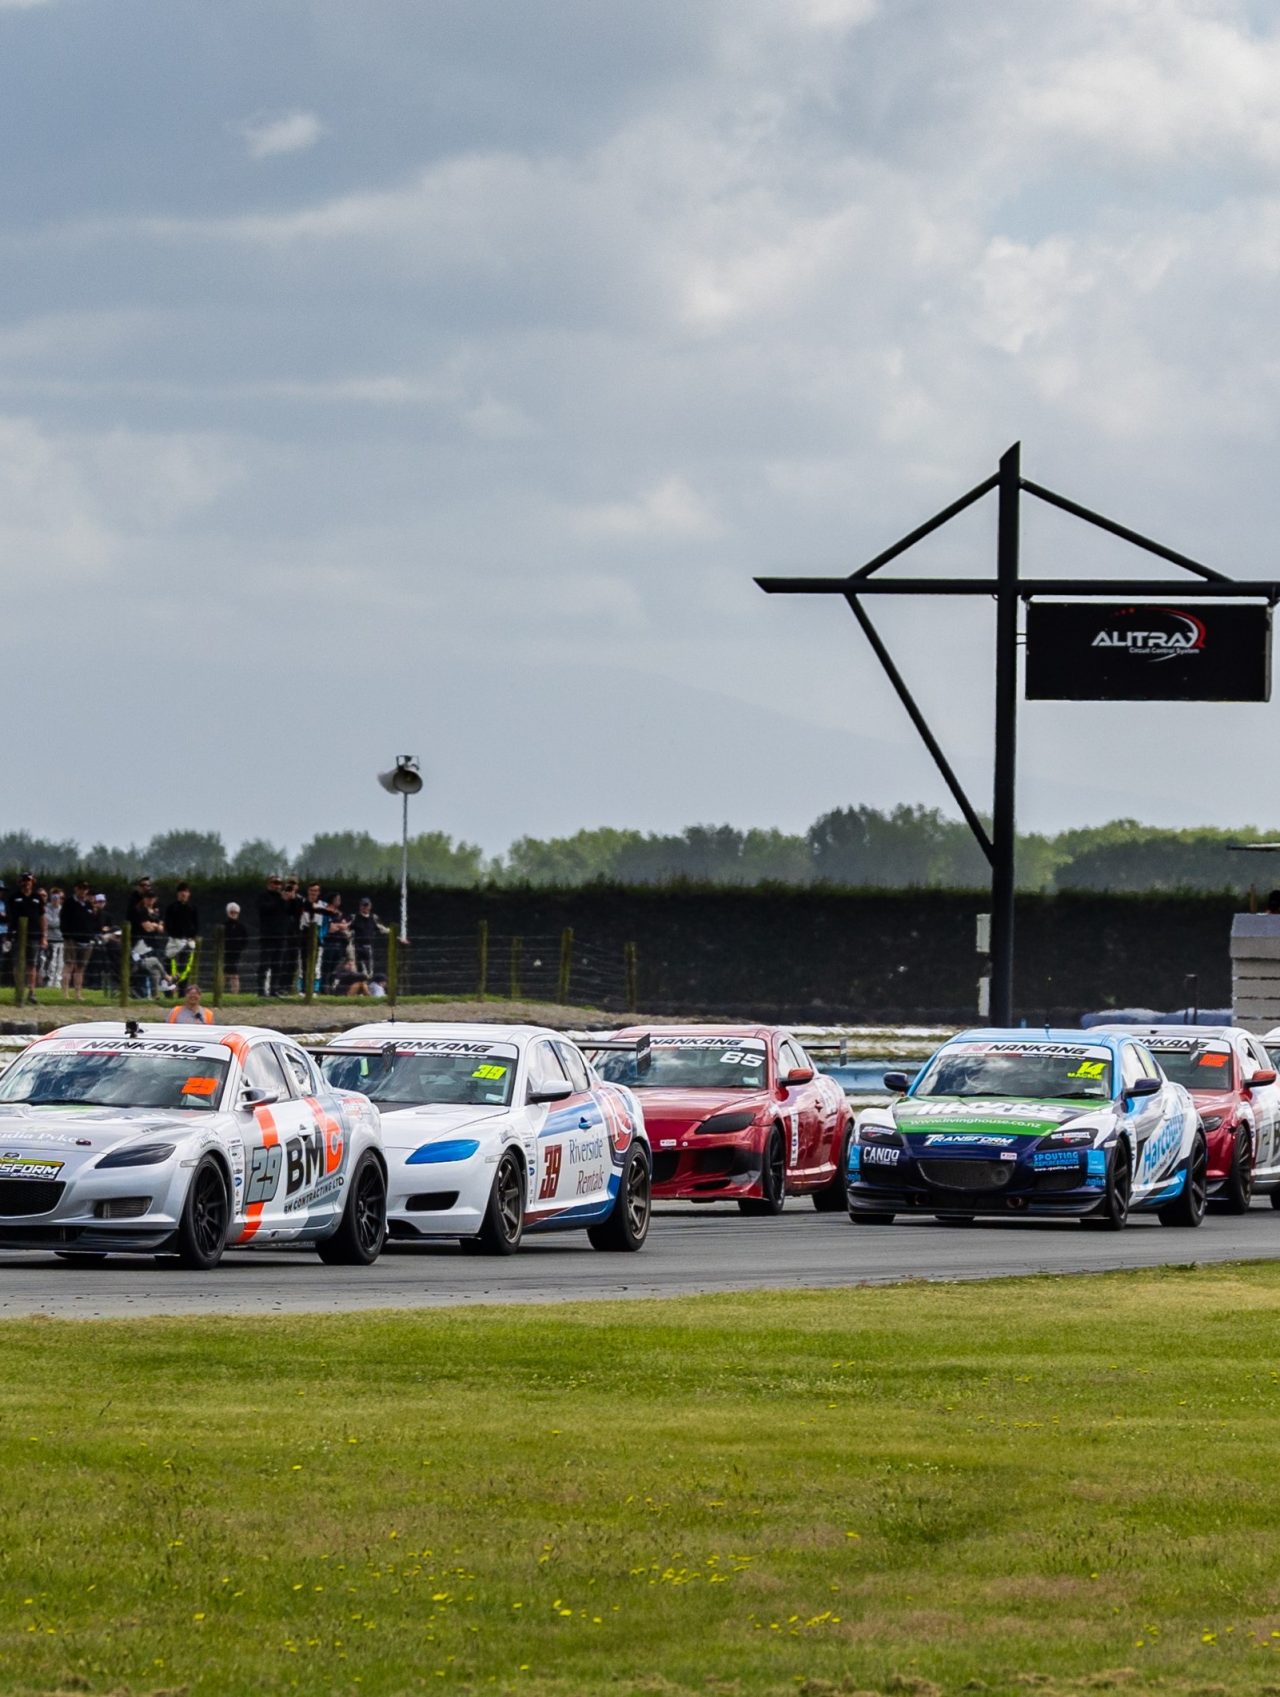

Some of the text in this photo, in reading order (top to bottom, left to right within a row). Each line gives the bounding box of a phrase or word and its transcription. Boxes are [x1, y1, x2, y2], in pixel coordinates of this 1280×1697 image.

[1091, 631, 1201, 647] ALITRAX
[83, 1040, 205, 1054] NANKANG
[650, 1037, 745, 1047] NANKANG
[988, 1044, 1091, 1055] NANKANG
[1137, 1037, 1211, 1049] NKANG
[719, 1050, 766, 1068] 65
[471, 1064, 508, 1080] 39
[1076, 1061, 1107, 1075] 14
[1067, 1072, 1103, 1080] MACKIE
[910, 1117, 1042, 1129] www.livinghouse.co.nz
[924, 1133, 1014, 1147] TRANSFORM
[285, 1115, 344, 1196] BMC
[569, 1138, 604, 1165] Riverside
[1033, 1151, 1079, 1161] SPOUTING
[245, 1143, 283, 1206] 29
[538, 1144, 563, 1200] 39
[576, 1164, 605, 1196] Rentals
[293, 1181, 332, 1210] CONTRACTING
